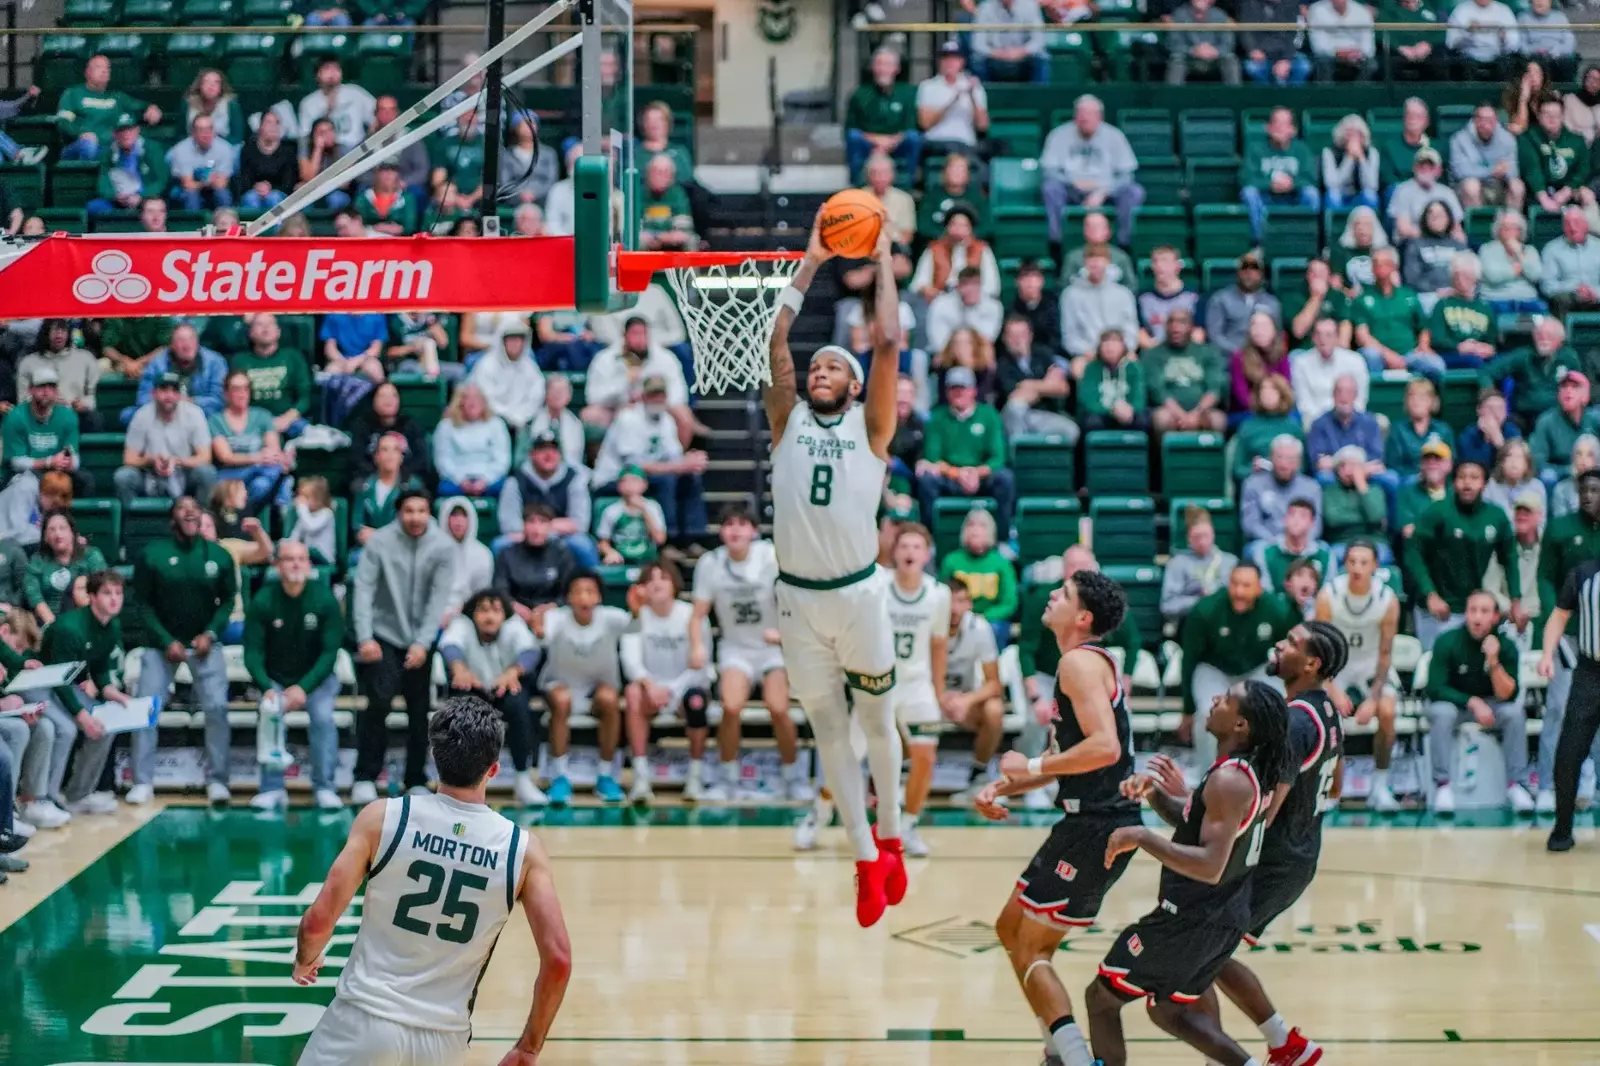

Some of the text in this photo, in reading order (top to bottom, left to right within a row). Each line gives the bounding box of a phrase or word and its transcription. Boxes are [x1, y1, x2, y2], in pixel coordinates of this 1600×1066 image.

[797, 435, 856, 450] COLORADO
[808, 446, 843, 459] STATE
[810, 465, 833, 507] 8
[412, 831, 499, 870] MORTON
[392, 860, 489, 944] 25
